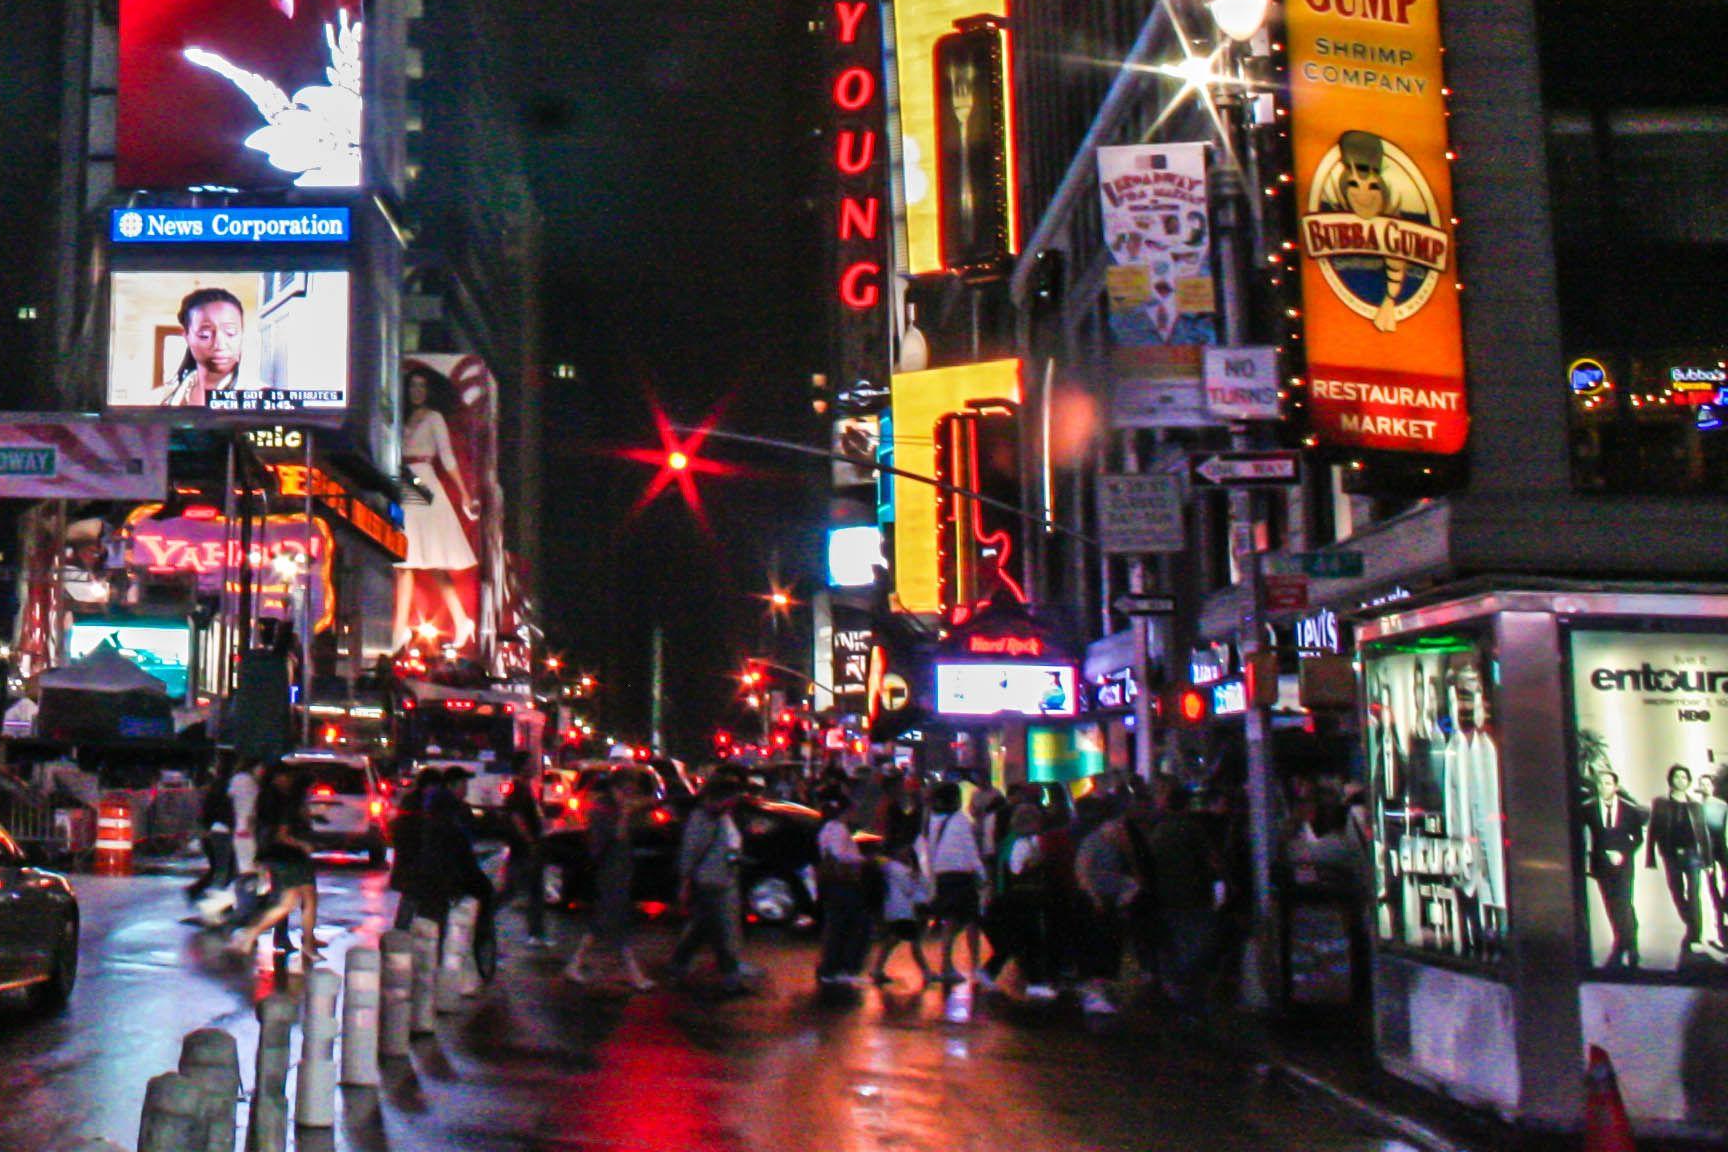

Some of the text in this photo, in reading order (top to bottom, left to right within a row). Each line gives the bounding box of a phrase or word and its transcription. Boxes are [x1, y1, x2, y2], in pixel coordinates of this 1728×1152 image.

[1315, 38, 1414, 67] SHRIMP
[1303, 62, 1427, 96] COMPANY
[832, 1, 880, 310] YOUNG
[147, 213, 344, 241] News Corporation
[1383, 221, 1447, 265] GUMP
[1312, 378, 1460, 412] RESTAURANT
[1339, 412, 1438, 440] MARKET
[1677, 708, 1712, 723] HBO
